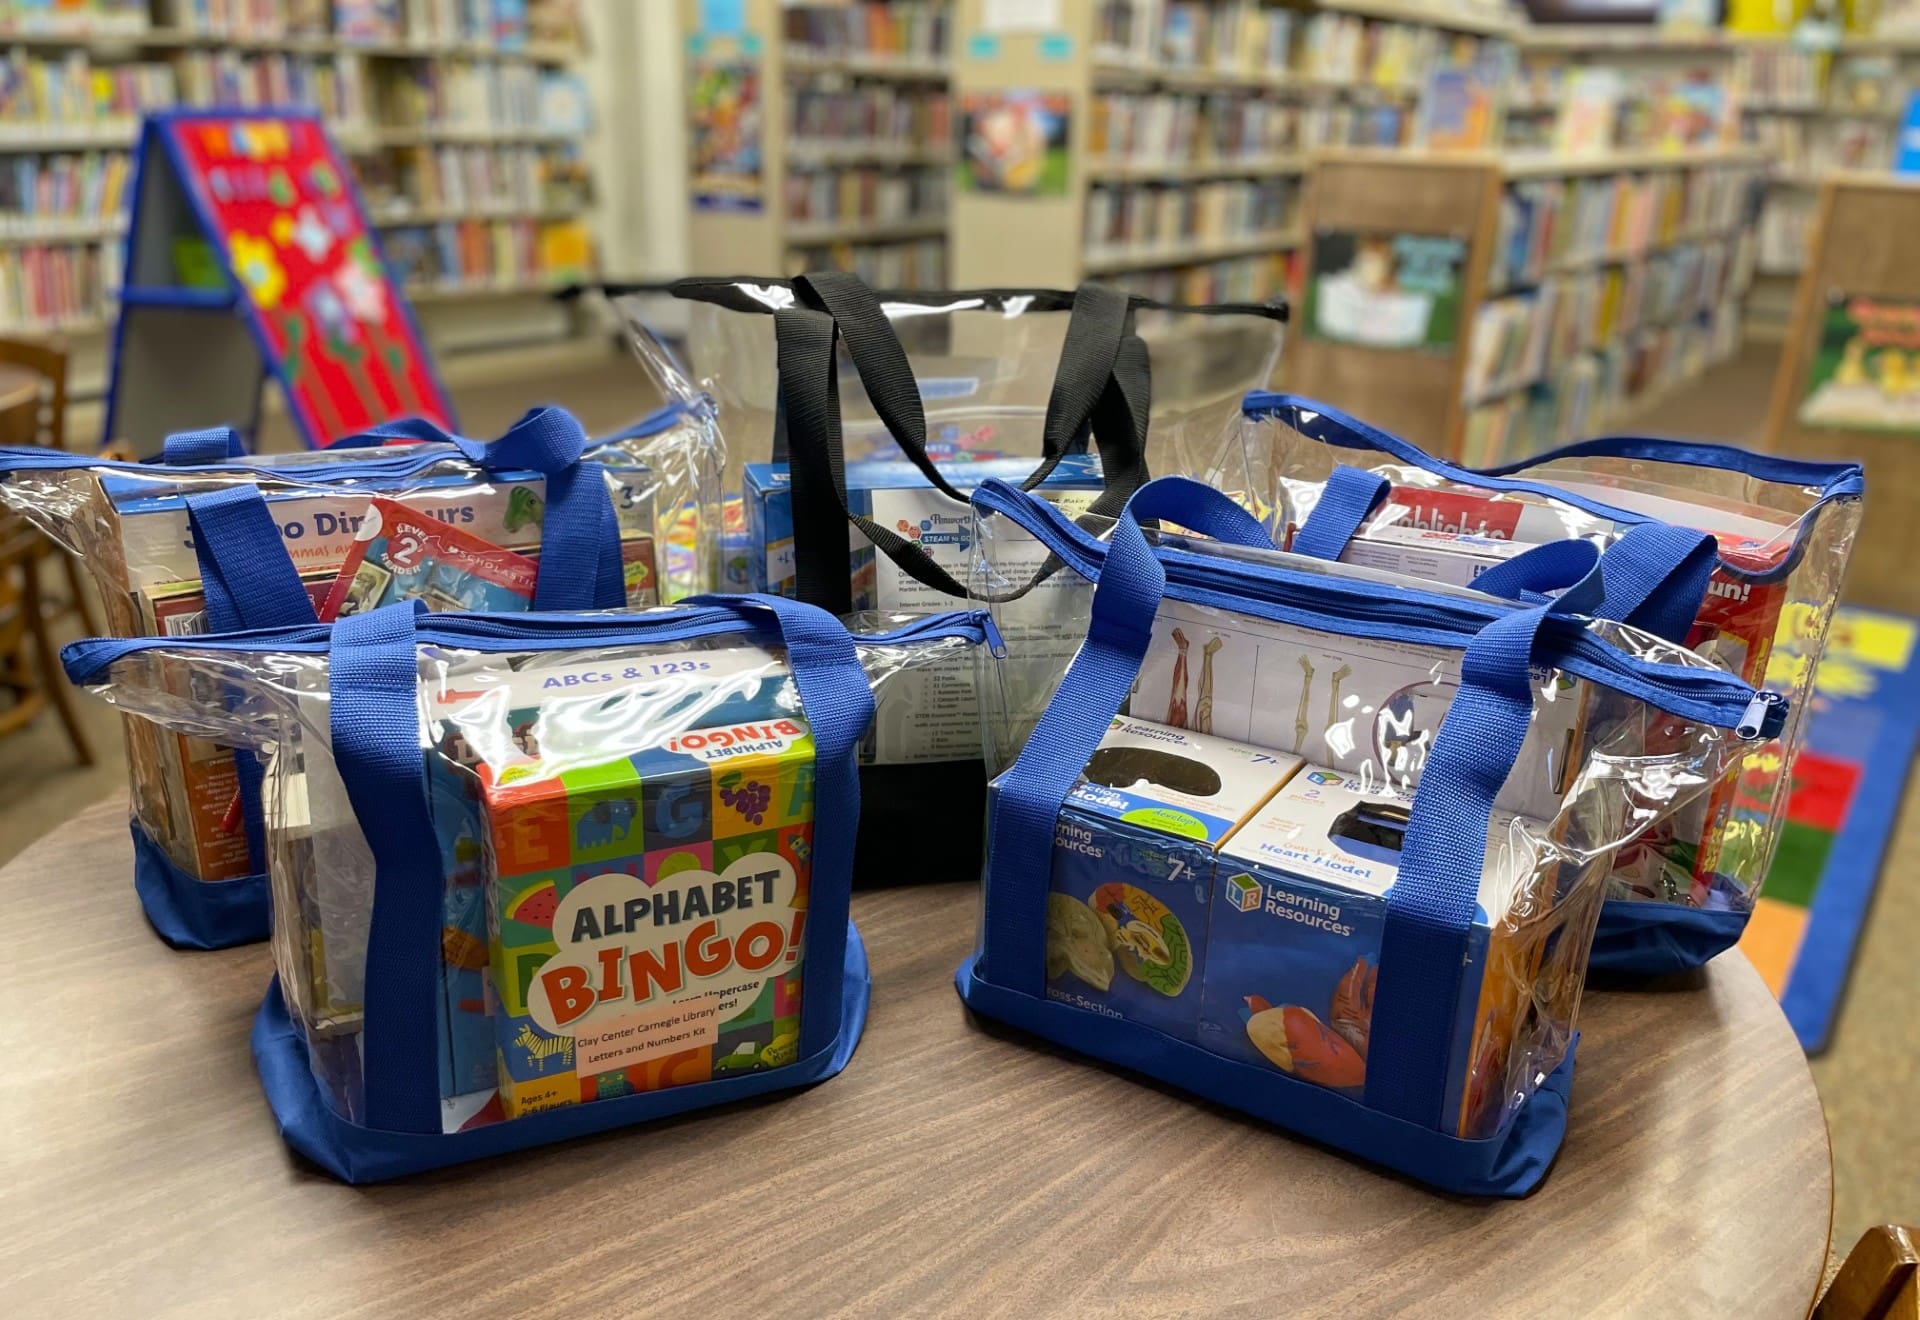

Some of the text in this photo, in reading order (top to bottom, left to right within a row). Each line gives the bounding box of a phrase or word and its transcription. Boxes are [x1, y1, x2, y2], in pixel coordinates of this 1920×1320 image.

[397, 524, 429, 545] LEVEL
[394, 537, 419, 564] 2
[381, 552, 422, 576] READER
[459, 551, 537, 589] SCHOLASTIC
[1707, 581, 1751, 601] un!
[542, 661, 711, 689] ABCs & 123s
[669, 720, 801, 752] BINGO!
[1121, 727, 1189, 747] Resources
[1126, 723, 1186, 741] Learning
[705, 740, 783, 759] ALPHABET
[1250, 754, 1279, 765] 7+
[1070, 788, 1129, 810] Model
[1056, 823, 1092, 844] rning
[1055, 836, 1103, 858] ources
[1260, 843, 1310, 862] Heart
[1167, 857, 1196, 881] 7+
[571, 869, 781, 943] ALPHABET
[1266, 884, 1341, 920] Learning
[1265, 900, 1351, 937] Resources
[541, 911, 805, 1028] BINGO!
[718, 999, 738, 1012] ers!
[578, 1007, 716, 1049] Clay Center Carnegie Library
[588, 1027, 707, 1063] Letters and Numbers Kit
